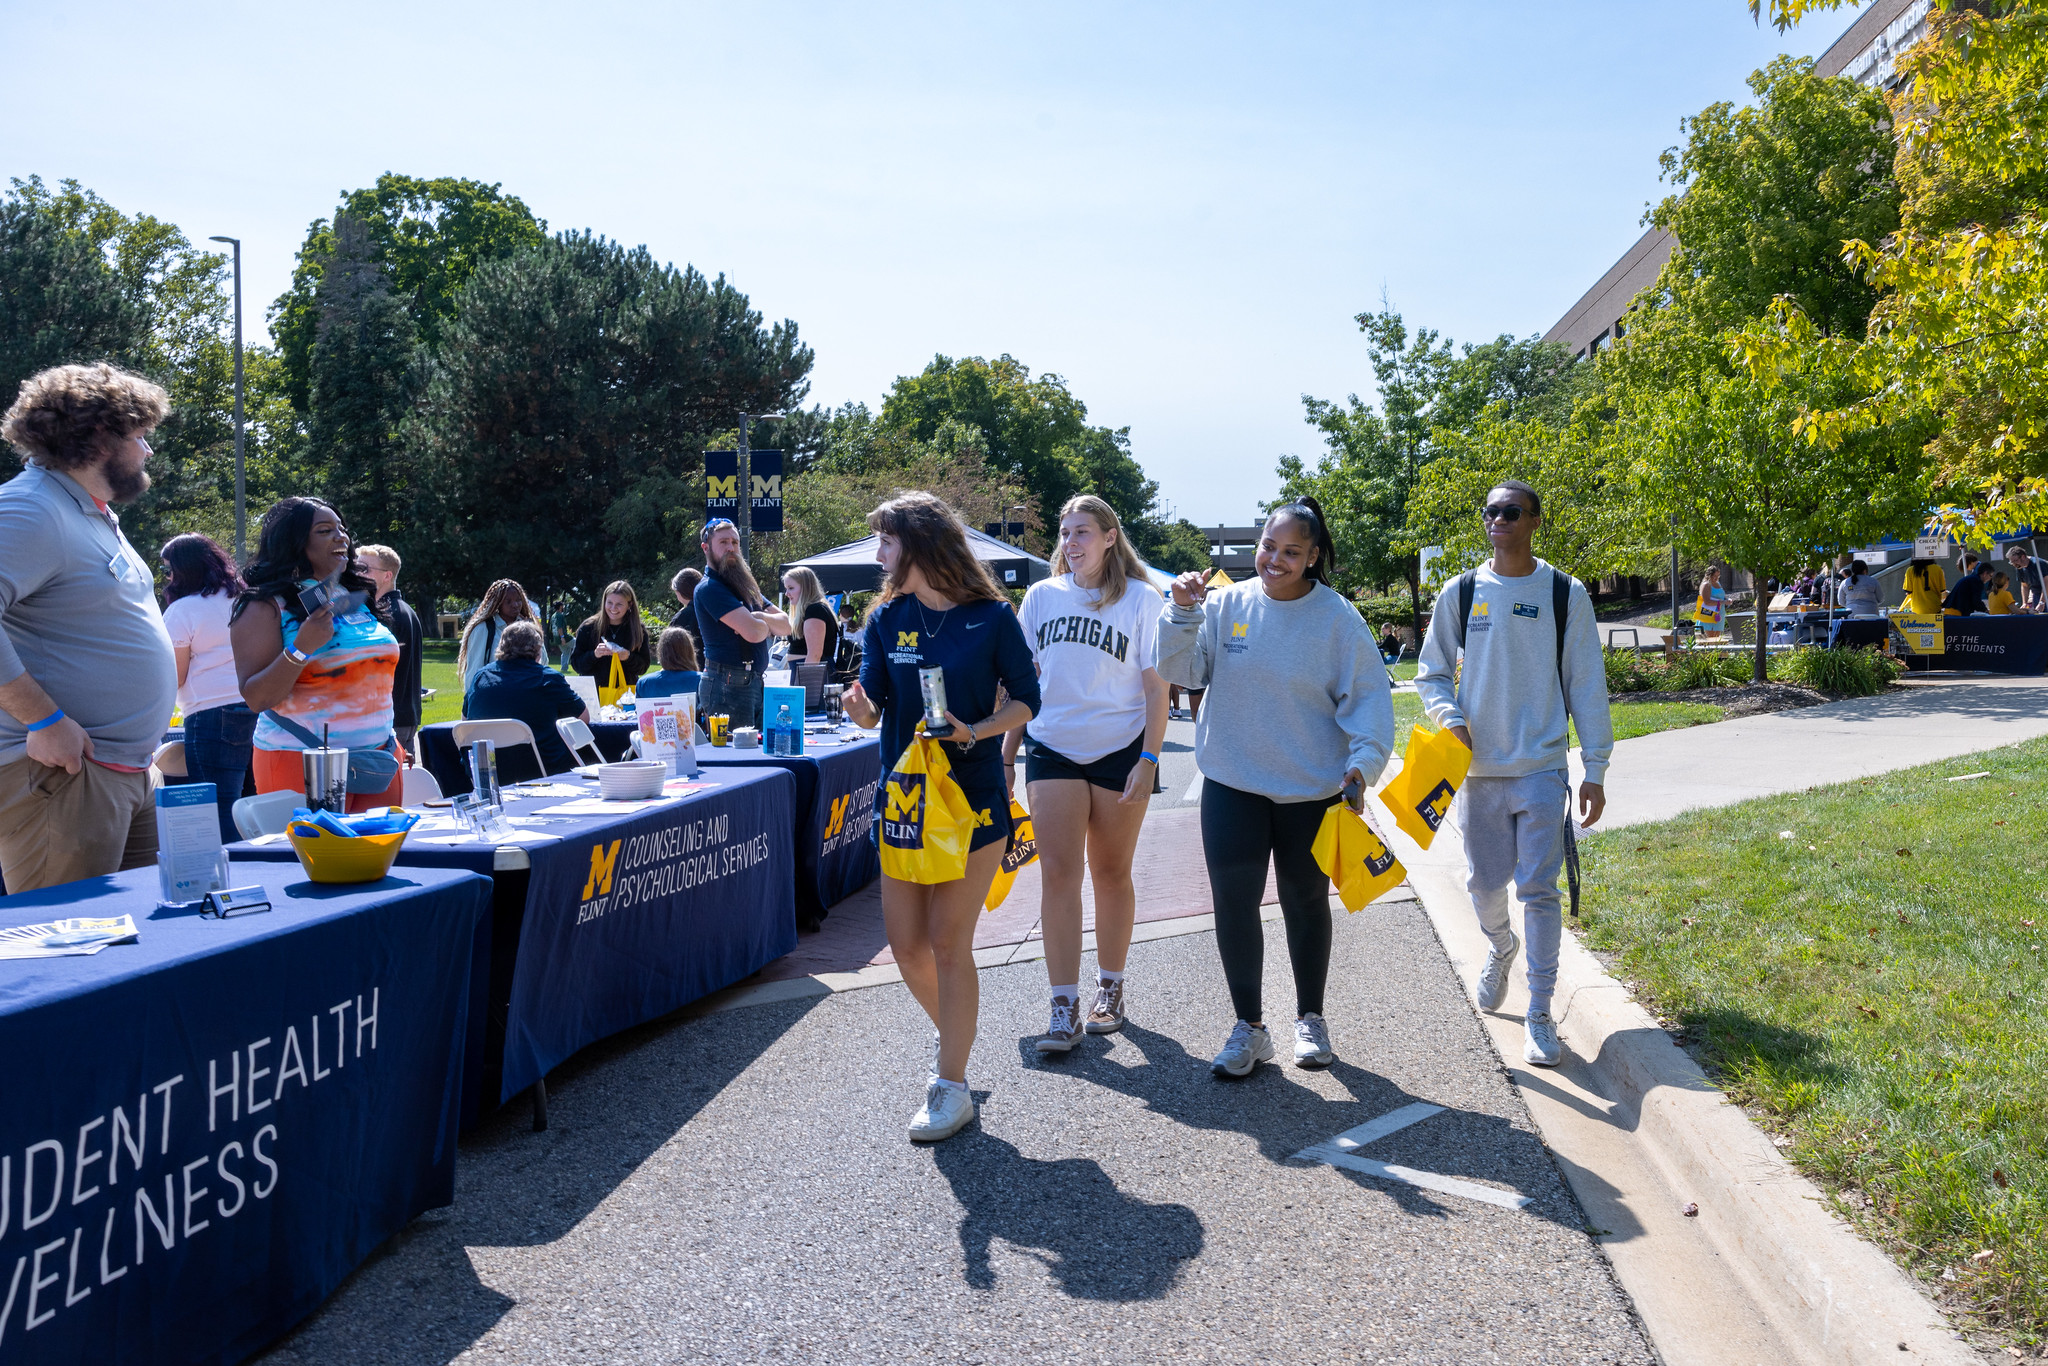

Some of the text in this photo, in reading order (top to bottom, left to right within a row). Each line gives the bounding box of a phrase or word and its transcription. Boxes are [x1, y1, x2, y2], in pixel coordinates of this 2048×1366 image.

[707, 475, 737, 498] M
[751, 474, 782, 498] M
[707, 498, 738, 507] FLINT
[752, 498, 782, 507] FLINT
[1472, 602, 1489, 616] M
[897, 631, 919, 647] M
[1036, 615, 1130, 664] MICHIGAN
[1232, 622, 1249, 637] M
[1946, 635, 1980, 644] OF THE
[888, 652, 924, 660] RECREATIONAL
[1954, 643, 2006, 654] STUDENTS
[885, 781, 922, 822] M
[824, 793, 850, 839] M
[972, 808, 995, 829] M
[1424, 806, 1442, 827] FLI
[625, 813, 729, 870] COUNSELING AND
[885, 822, 918, 840] FLIN
[821, 835, 840, 858] FLINT
[582, 839, 622, 901] M
[614, 832, 769, 911] PSYCHOLOGICAL SERVICES
[576, 896, 609, 925] FLINT
[208, 986, 380, 1132] HEALTH
